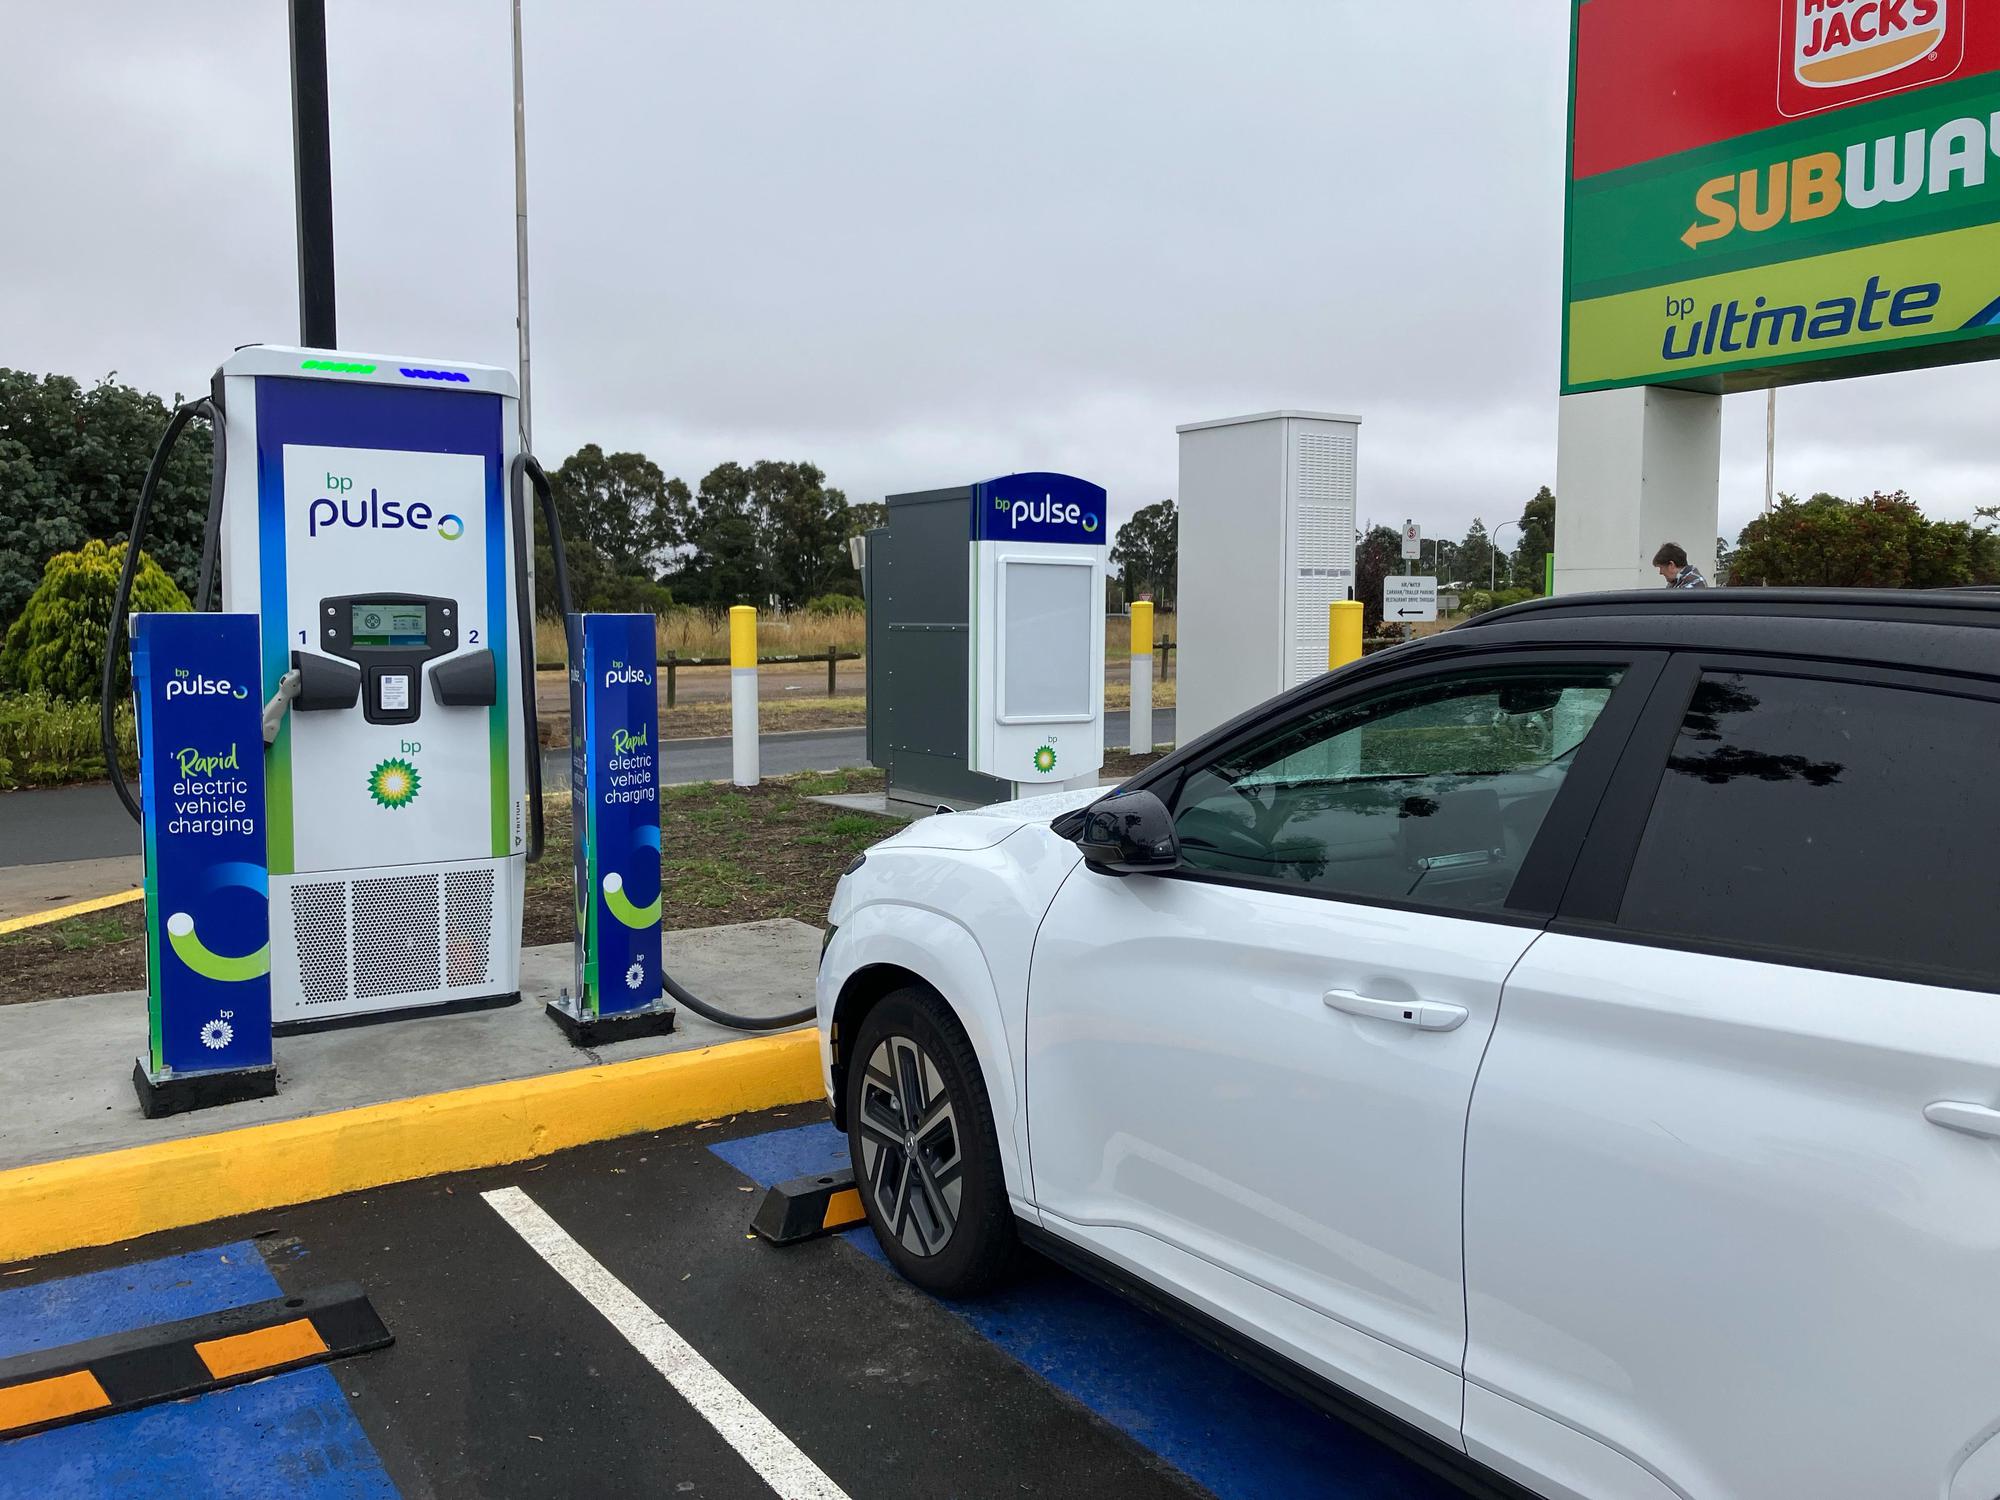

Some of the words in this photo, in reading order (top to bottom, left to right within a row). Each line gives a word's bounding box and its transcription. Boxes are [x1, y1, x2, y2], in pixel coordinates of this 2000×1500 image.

[1665, 295, 1695, 320] bp
[1661, 275, 1942, 361] ultimate
[326, 472, 353, 494] bp
[309, 488, 433, 537] pulse
[994, 496, 1010, 511] bp
[1011, 493, 1081, 529] pulse
[298, 630, 307, 645] 1
[468, 630, 480, 645] 2
[175, 668, 189, 679] bp
[612, 660, 623, 669] bp
[606, 665, 644, 688] pulse
[166, 674, 231, 700] pulse
[400, 738, 422, 756] bp
[612, 723, 647, 756] Rapid
[1048, 735, 1057, 744] bp
[176, 743, 239, 779] Rapid
[609, 753, 652, 770] electric
[173, 778, 247, 795] electric
[610, 769, 651, 787] vehicle
[605, 786, 655, 804] charging
[175, 797, 246, 814] vehicle
[168, 815, 254, 836] charging
[636, 953, 645, 963] bp
[219, 1008, 234, 1019] bp
